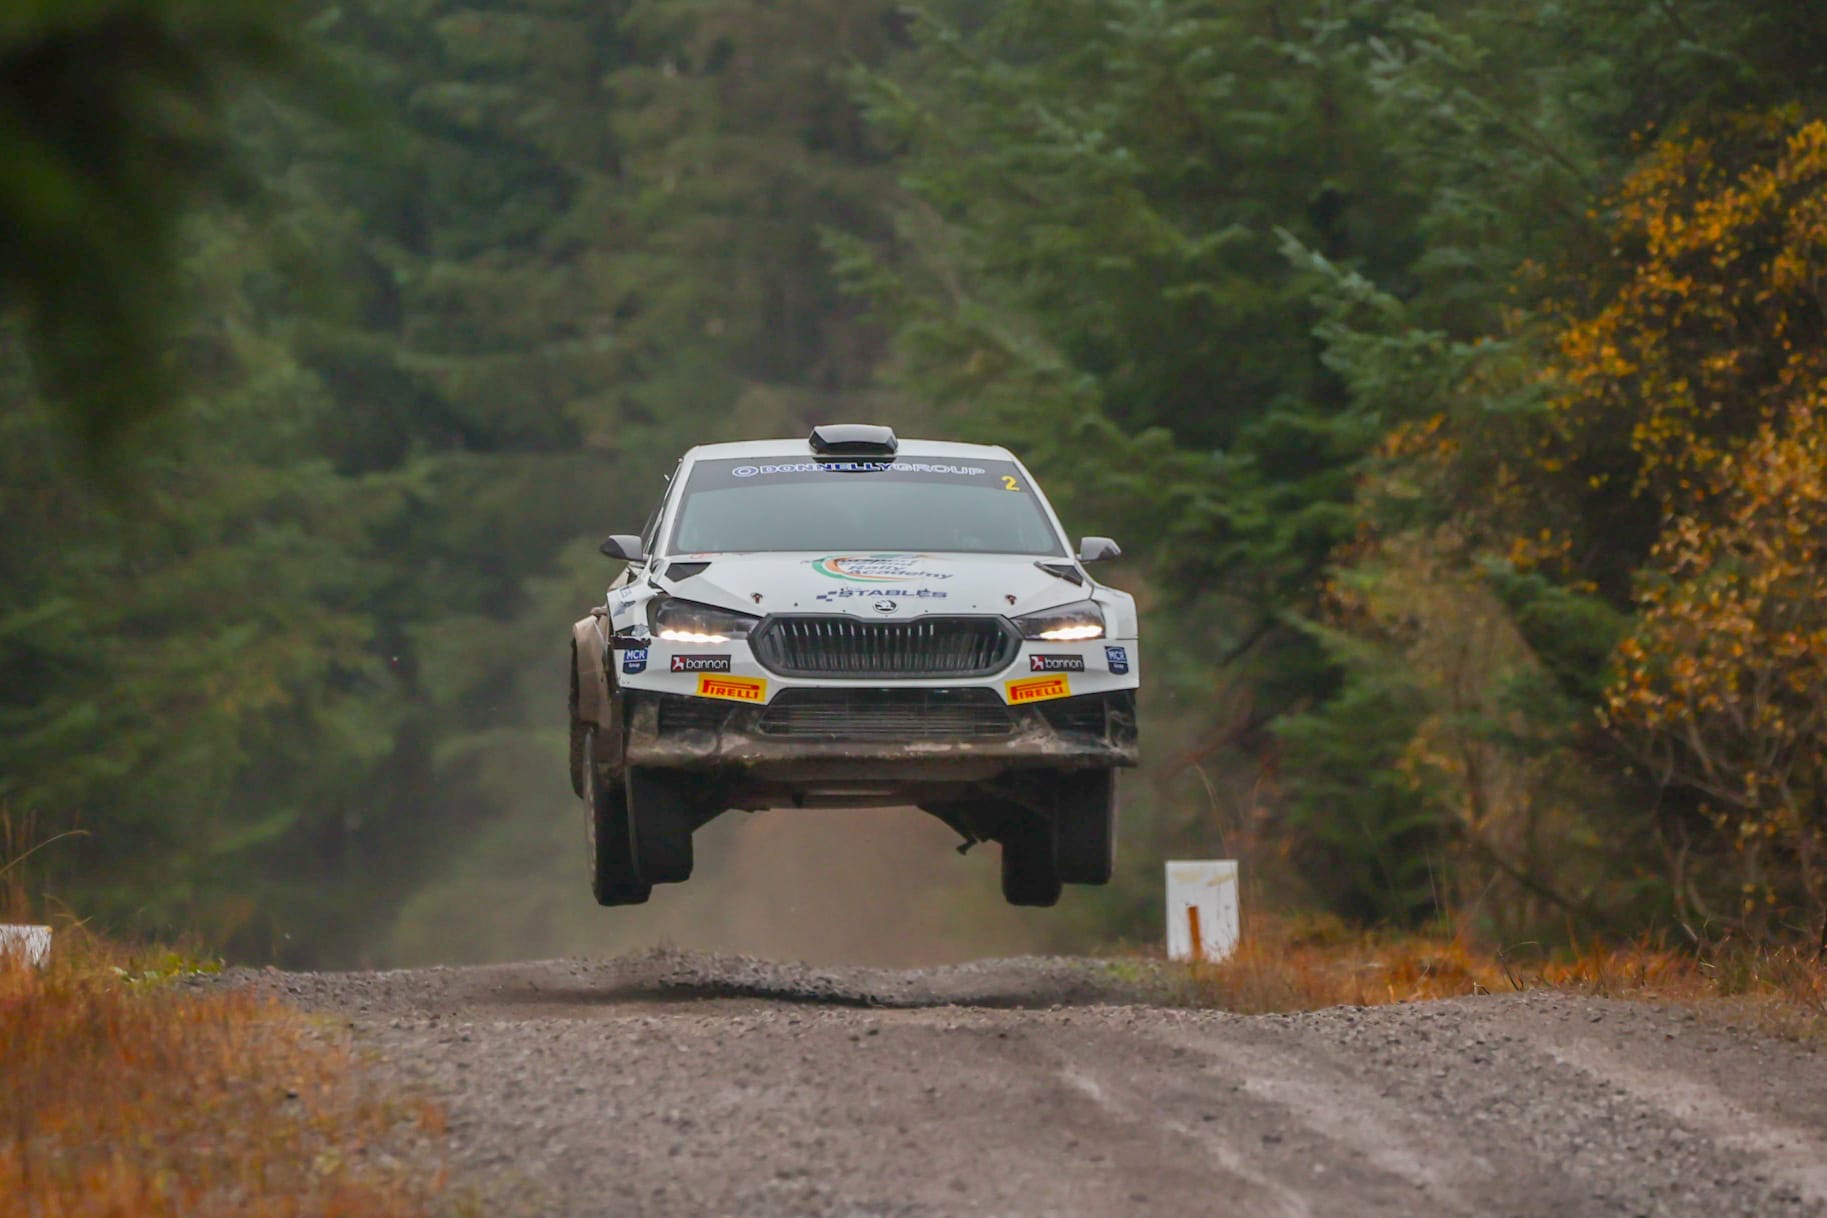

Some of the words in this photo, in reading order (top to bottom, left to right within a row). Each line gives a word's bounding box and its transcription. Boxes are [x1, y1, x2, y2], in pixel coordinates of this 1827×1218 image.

[1001, 475, 1020, 491] 2
[838, 589, 948, 598] STABLES
[626, 649, 646, 660] MCR
[686, 657, 729, 669] bannon
[1045, 657, 1083, 669] bannon
[702, 679, 760, 700] PIRELLI
[1010, 680, 1064, 701] PIRELLI
